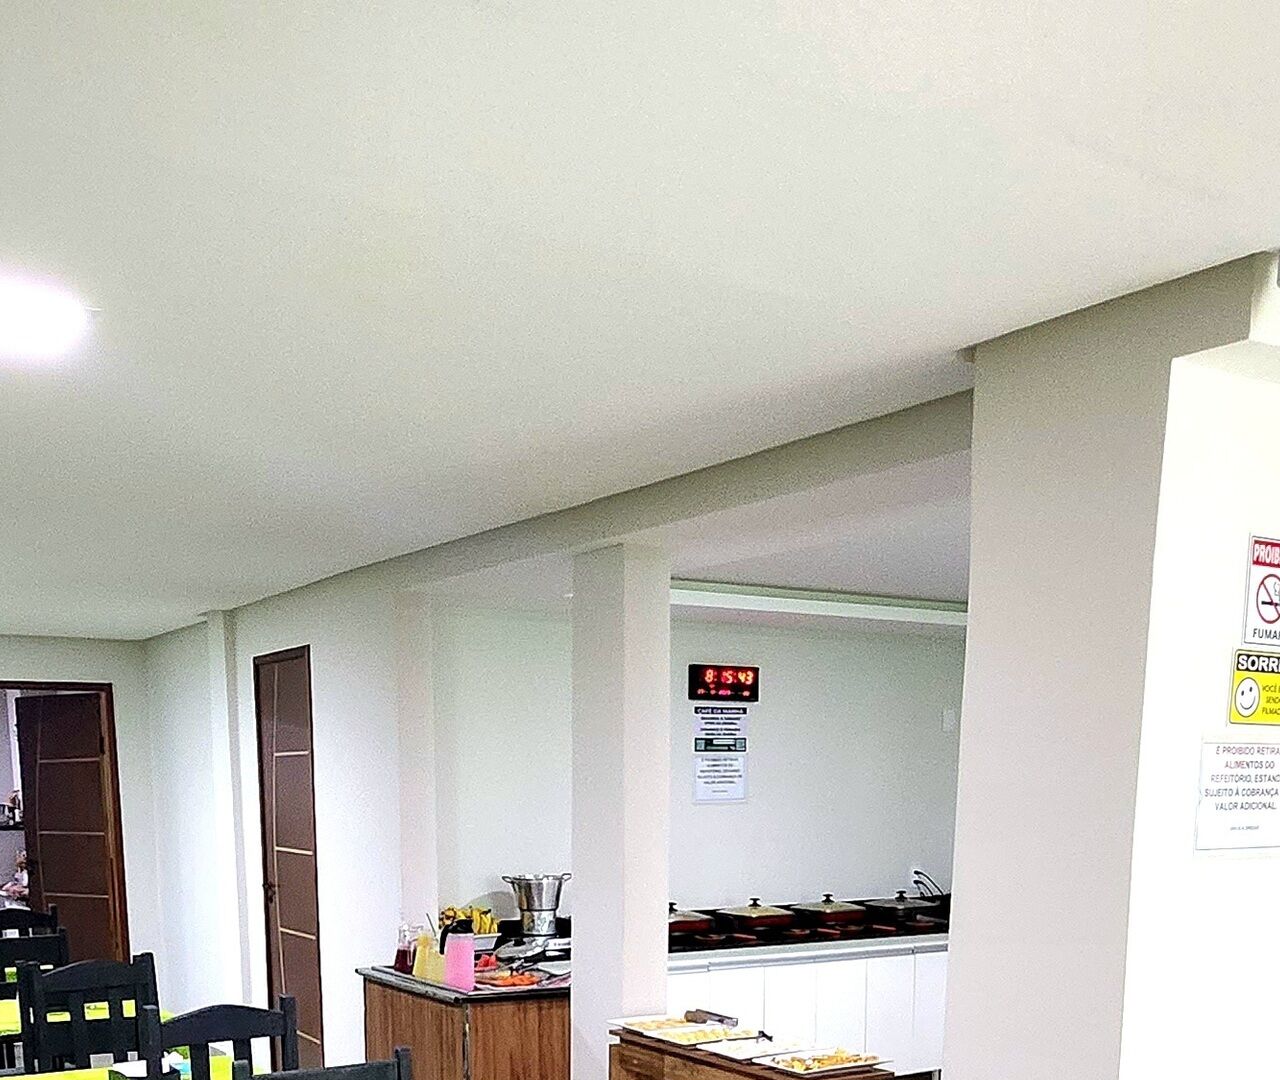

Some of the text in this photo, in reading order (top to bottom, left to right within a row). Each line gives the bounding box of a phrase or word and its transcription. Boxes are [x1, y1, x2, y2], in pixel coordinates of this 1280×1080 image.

[1222, 746, 1256, 756] PROIBIDO
[1224, 760, 1276, 770] ALIMENTOS DO
[1204, 787, 1234, 798] SUJEITO
[1241, 787, 1279, 799] COBRANÇA
[1214, 801, 1239, 811] VALOR
